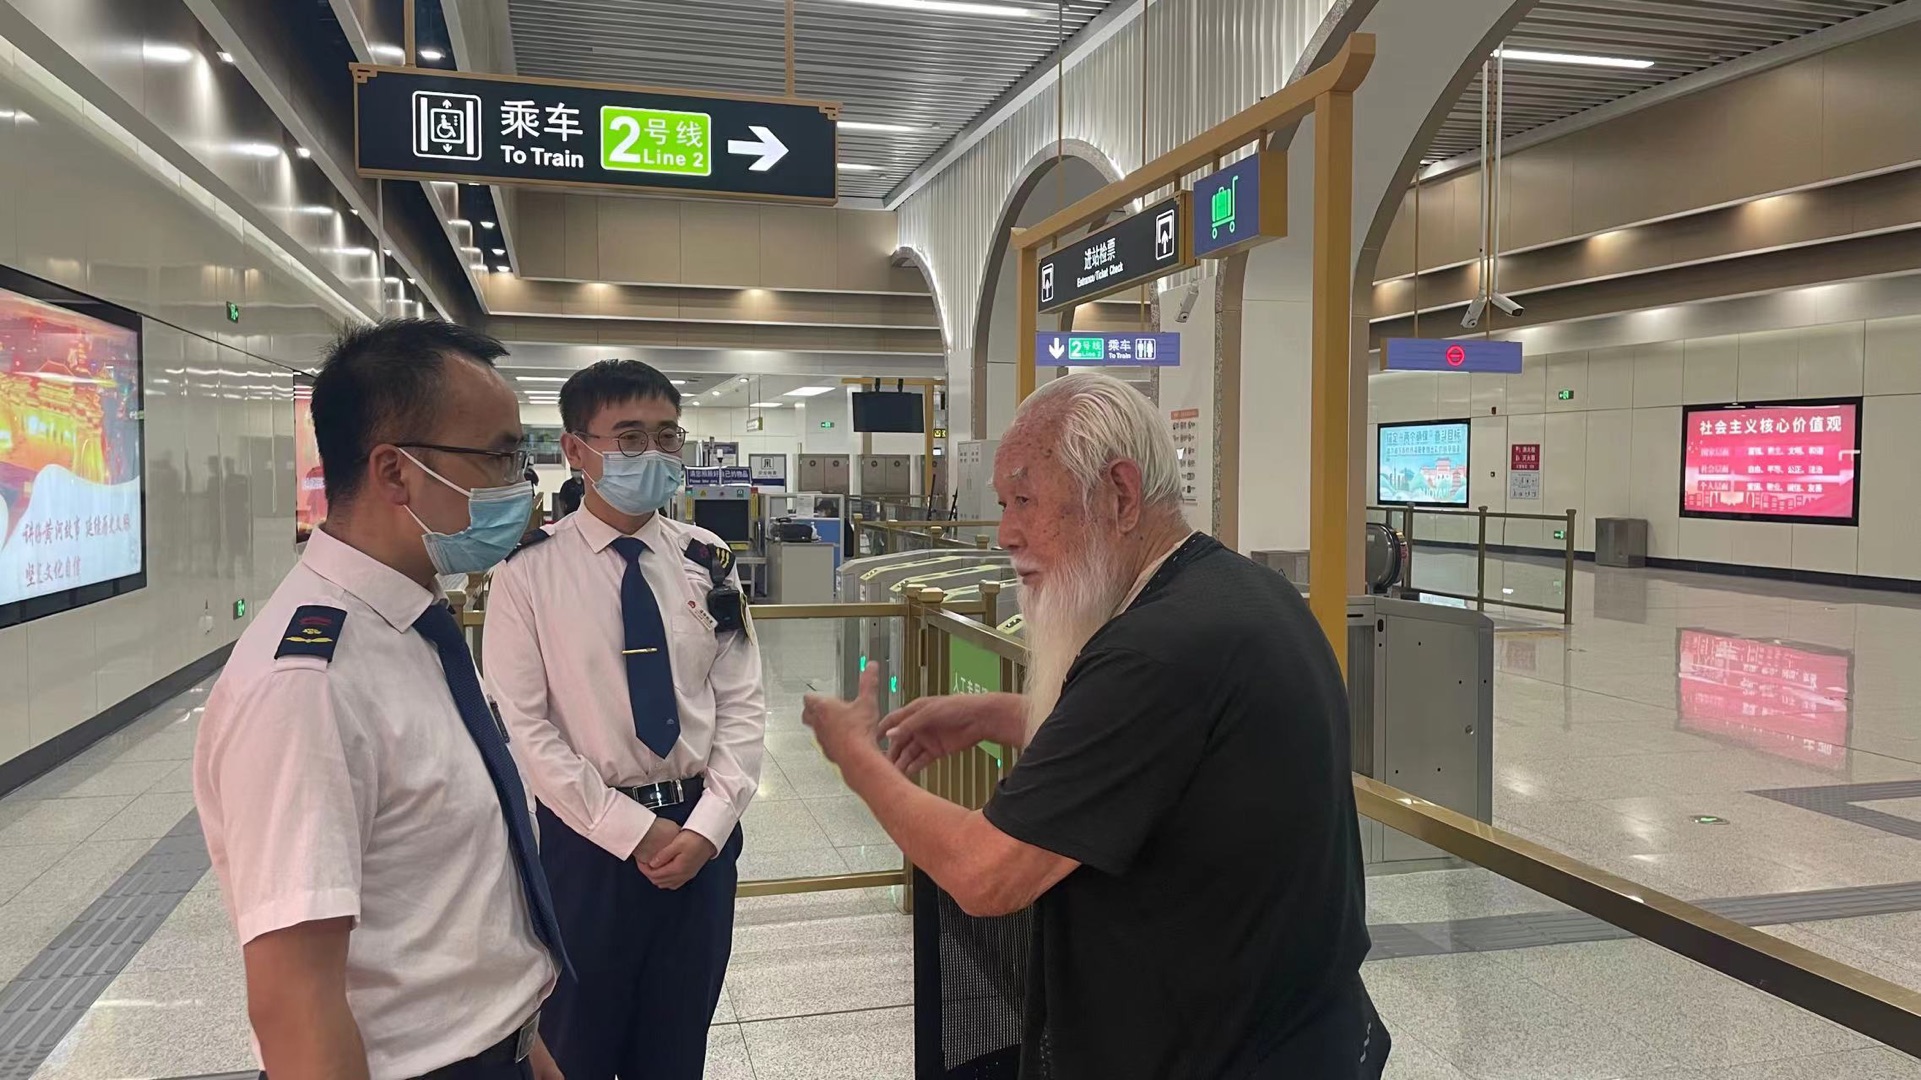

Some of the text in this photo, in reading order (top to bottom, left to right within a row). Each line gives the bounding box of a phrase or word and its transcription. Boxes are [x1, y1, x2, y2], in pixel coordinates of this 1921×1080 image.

[500, 100, 583, 142] 乘车
[500, 145, 584, 168] To Train
[643, 149, 704, 168] Line 2
[1083, 237, 1116, 270] 进站检票
[1108, 339, 1131, 351] 乘车
[1699, 415, 1842, 436] 社会主义核心价值观
